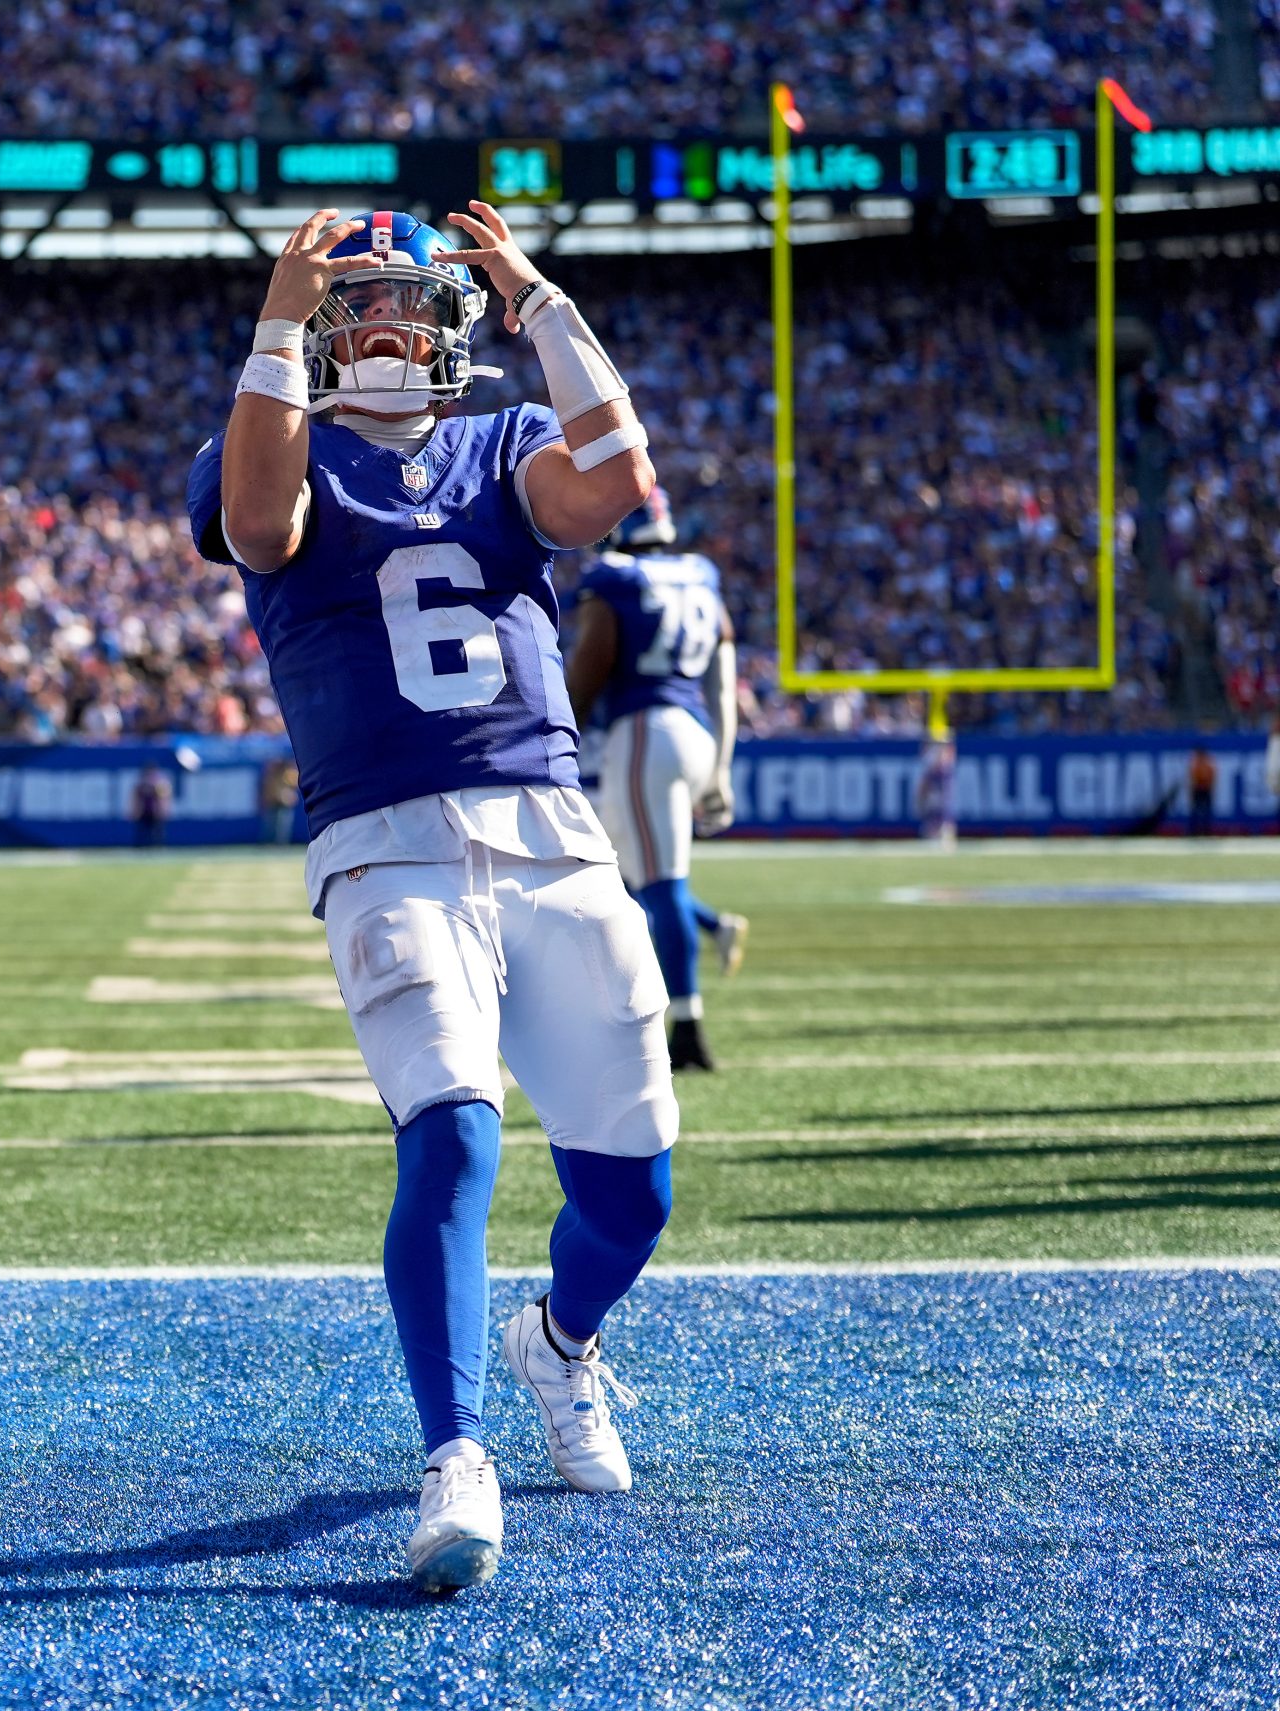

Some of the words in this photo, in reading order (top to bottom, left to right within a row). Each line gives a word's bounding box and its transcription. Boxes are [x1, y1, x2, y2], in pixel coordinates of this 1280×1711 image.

[372, 227, 392, 250] 6
[515, 286, 532, 302] HYPE
[376, 542, 508, 712] 6
[637, 584, 718, 678] 78
[757, 756, 1052, 821] FOOTALL
